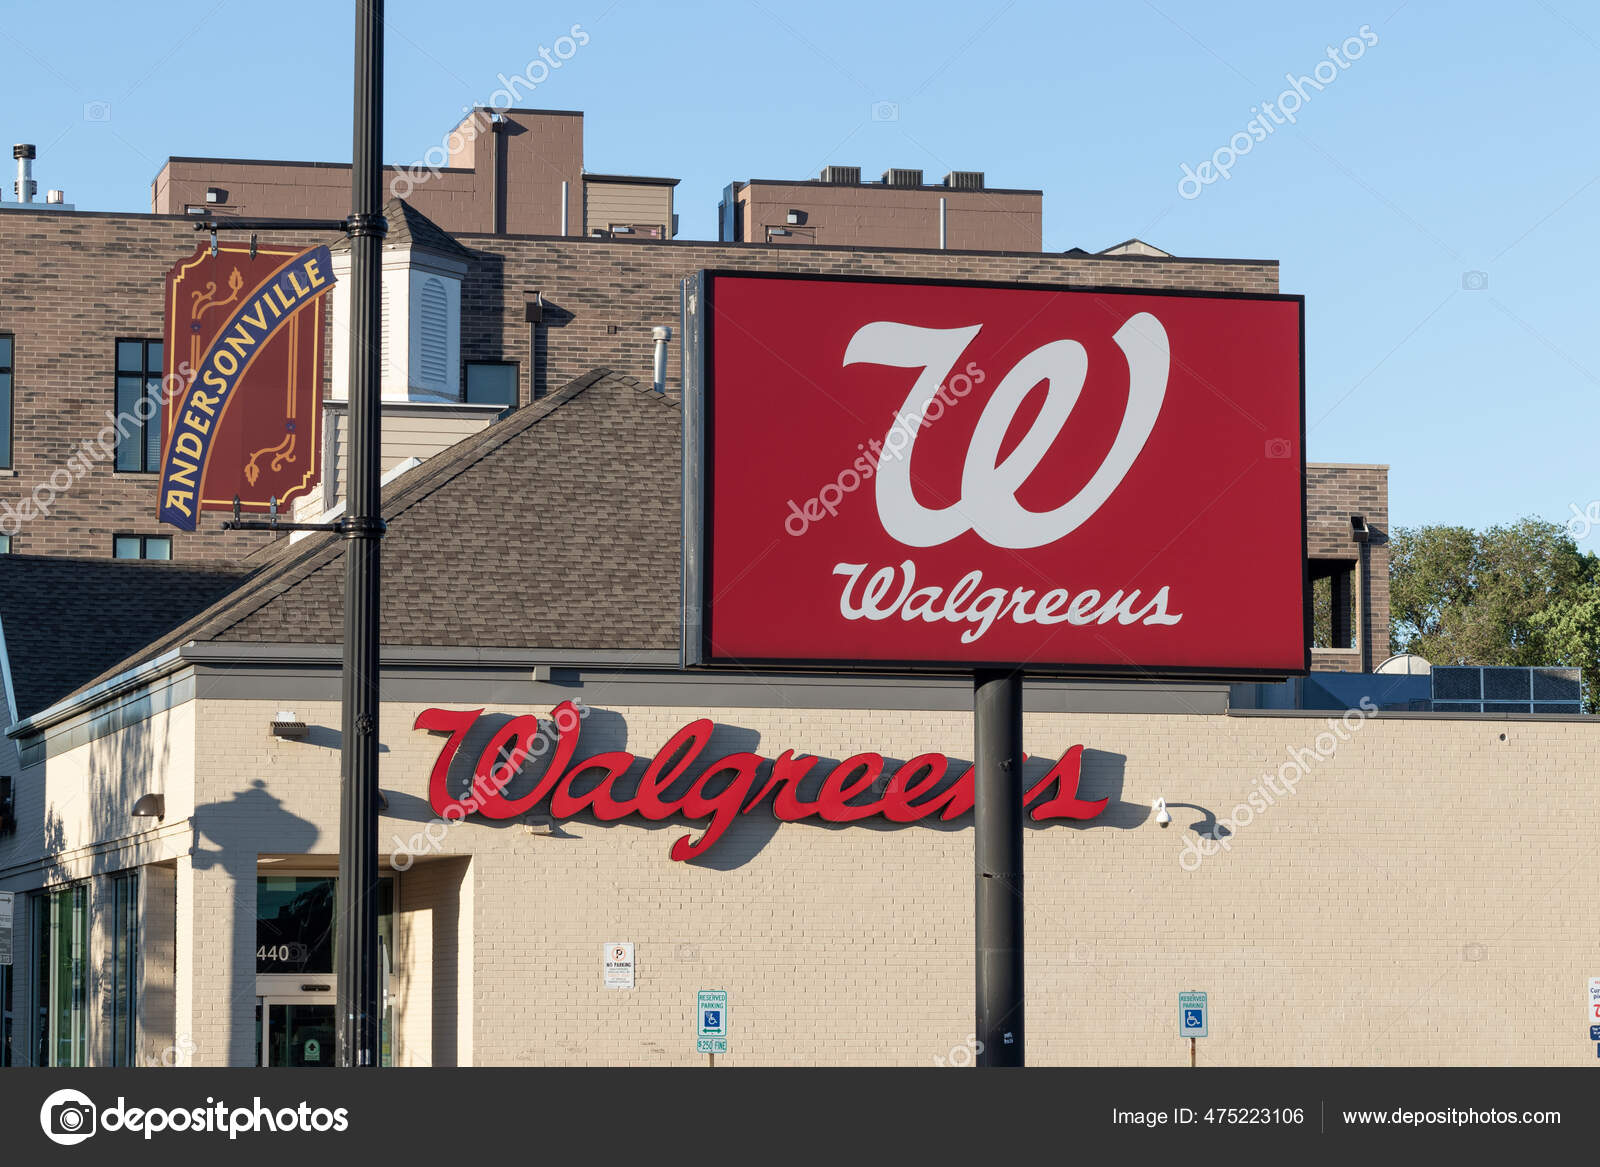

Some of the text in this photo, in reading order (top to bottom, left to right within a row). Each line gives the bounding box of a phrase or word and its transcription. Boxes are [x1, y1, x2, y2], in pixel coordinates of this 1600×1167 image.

[165, 258, 325, 518] ANDERSONVILLE
[843, 312, 1171, 549] W
[833, 560, 1183, 644] Walgreens
[256, 945, 289, 961] 440
[715, 1041, 726, 1050] FINE
